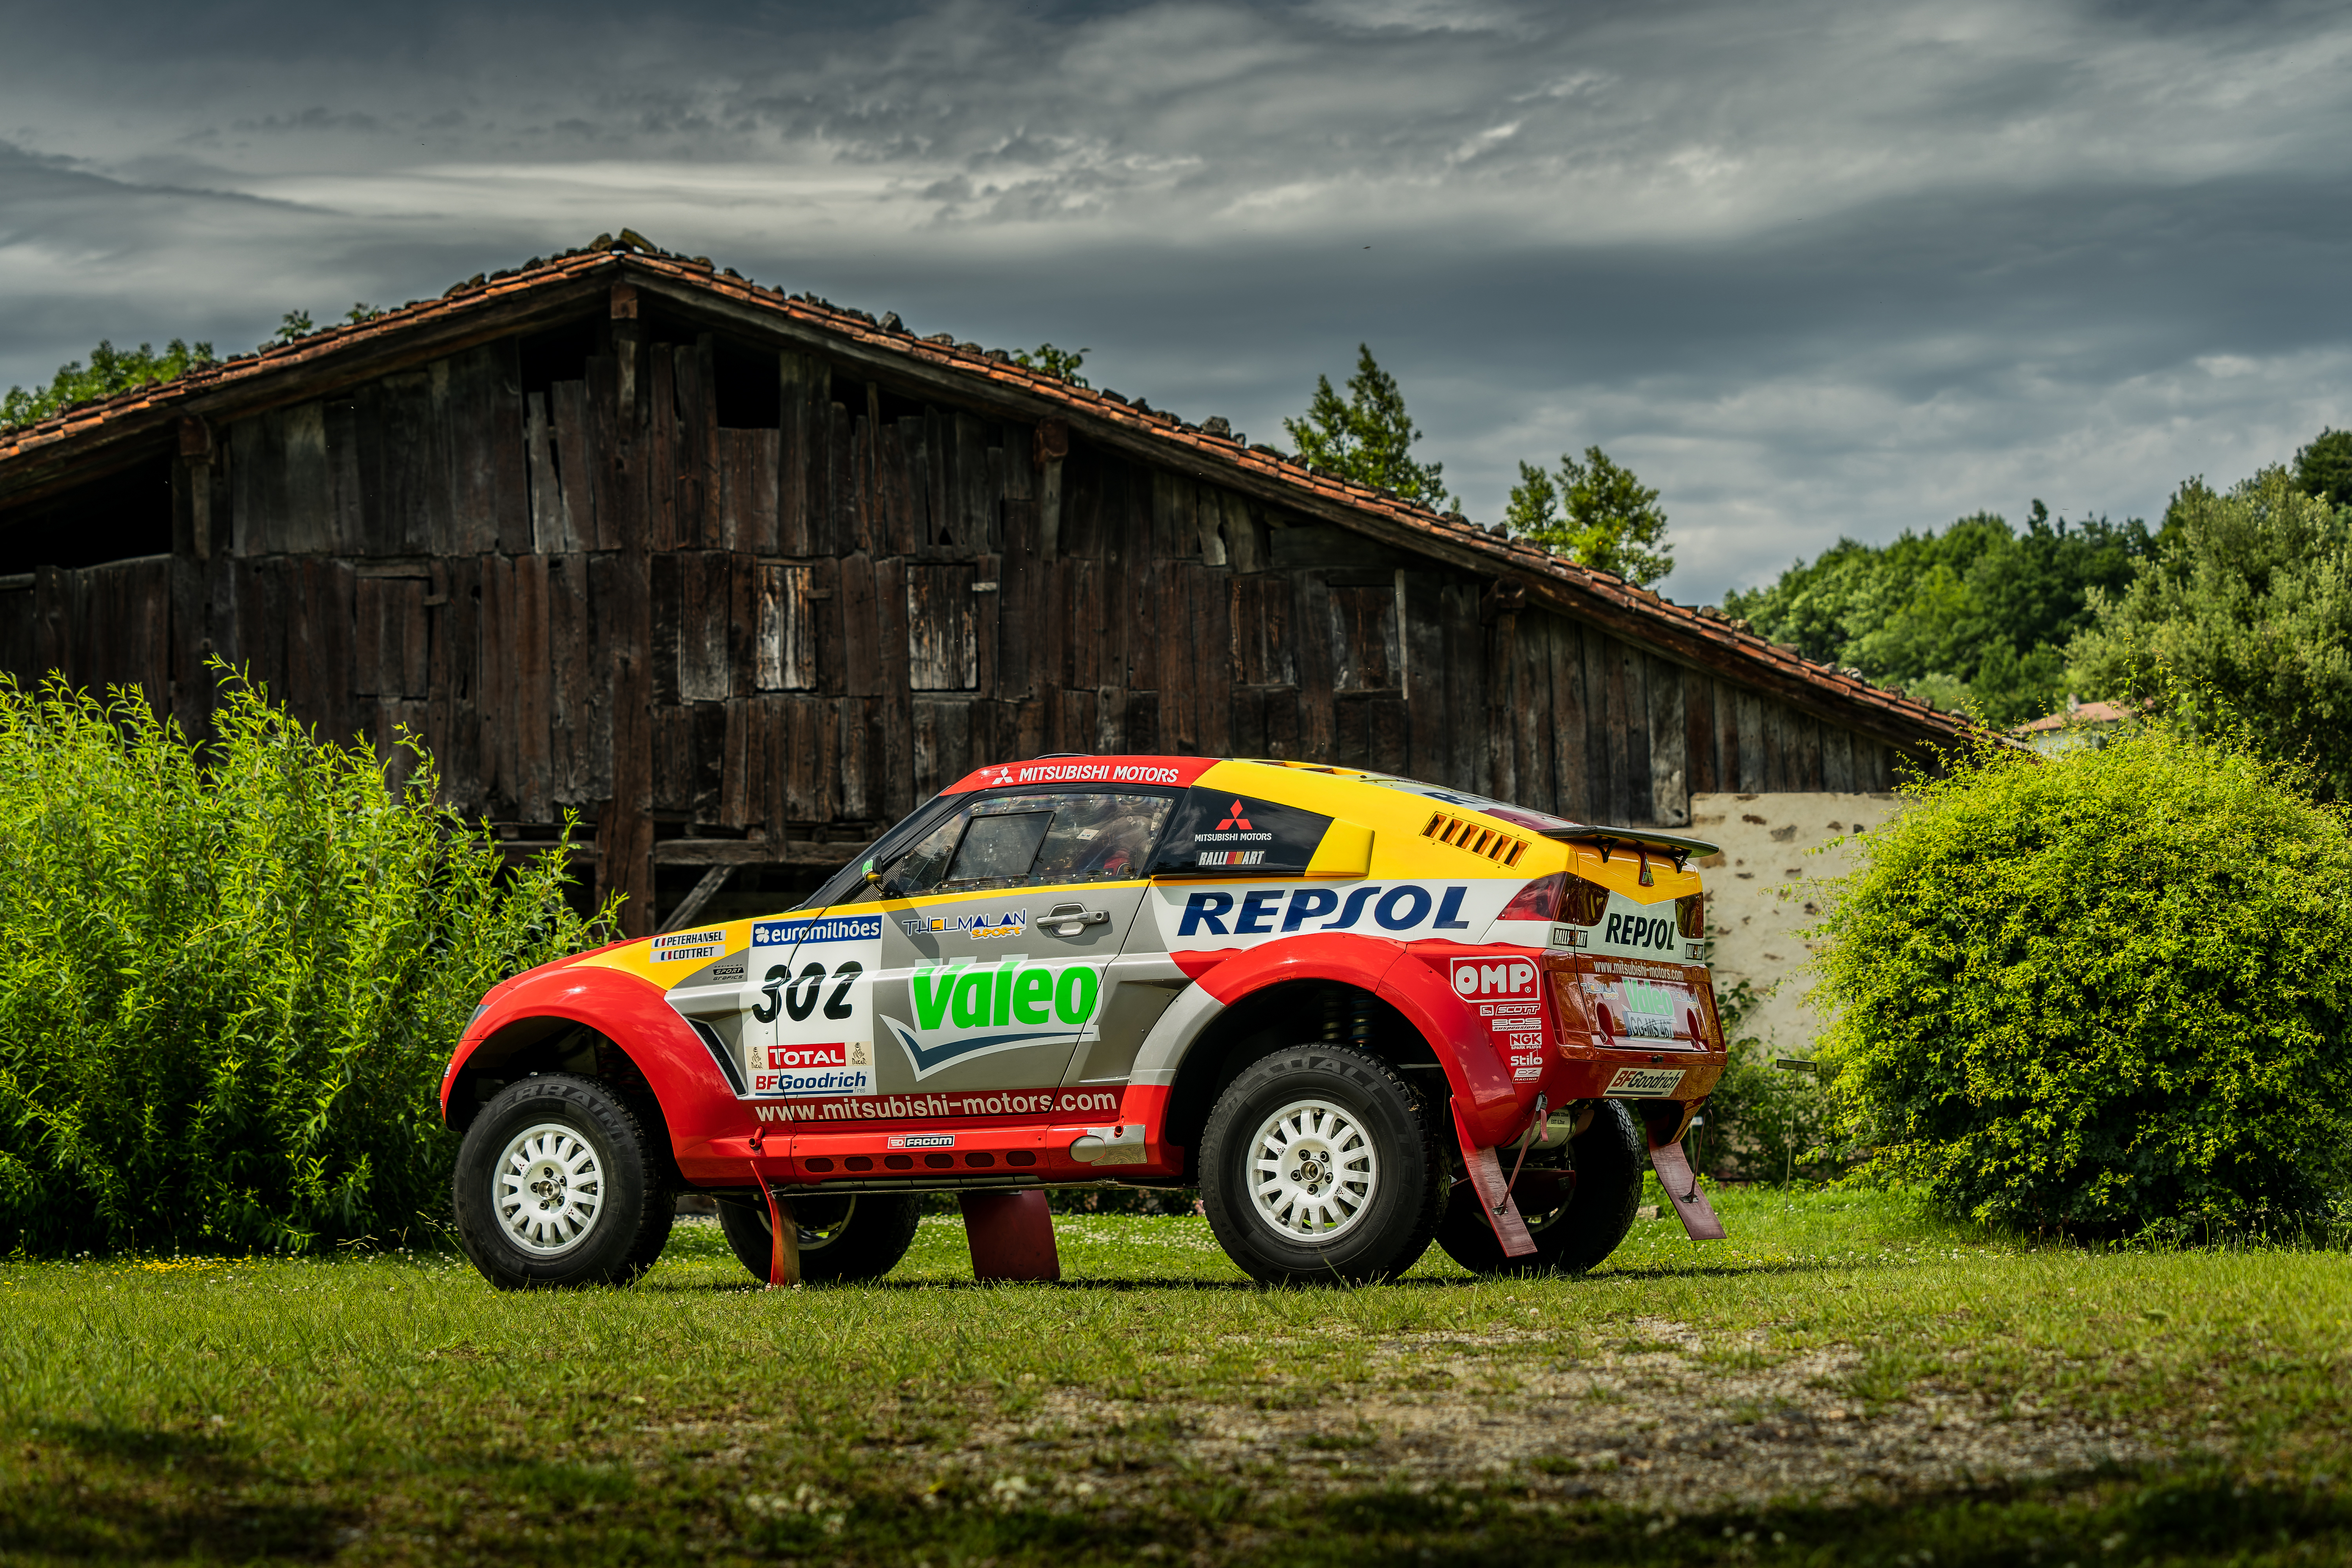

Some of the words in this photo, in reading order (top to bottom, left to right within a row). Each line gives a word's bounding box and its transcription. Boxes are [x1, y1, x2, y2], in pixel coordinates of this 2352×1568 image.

[1018, 765, 1109, 782] MITSUBISHI
[1113, 766, 1179, 783] MOTORS
[1194, 833, 1239, 842] MITSUBISHI
[1240, 833, 1272, 841] MOTORS
[1177, 885, 1470, 936] REPSOL
[771, 920, 880, 942] euromilhões
[902, 909, 1026, 935] THELMALAN
[667, 931, 723, 947] PETERHANSEL
[971, 926, 1024, 938] SPORT
[1604, 913, 1675, 951] REPSOL
[673, 947, 715, 960] COTTRET
[1455, 964, 1534, 995] OMP
[1593, 959, 1684, 981] www.mitsubishi-motors.com
[752, 960, 863, 1023] 302
[1497, 1005, 1538, 1014] SCOTT
[1492, 1017, 1541, 1026] BOS
[1511, 1034, 1541, 1045] NGK
[769, 1047, 845, 1067] TOTAL
[1510, 1051, 1543, 1065] Stilo
[755, 1071, 866, 1090] BFGoodrich
[1610, 1070, 1681, 1089] BFGoodrich
[755, 1091, 1117, 1122] www.mitsubishi-motors.com
[907, 1136, 953, 1147] FACOM
